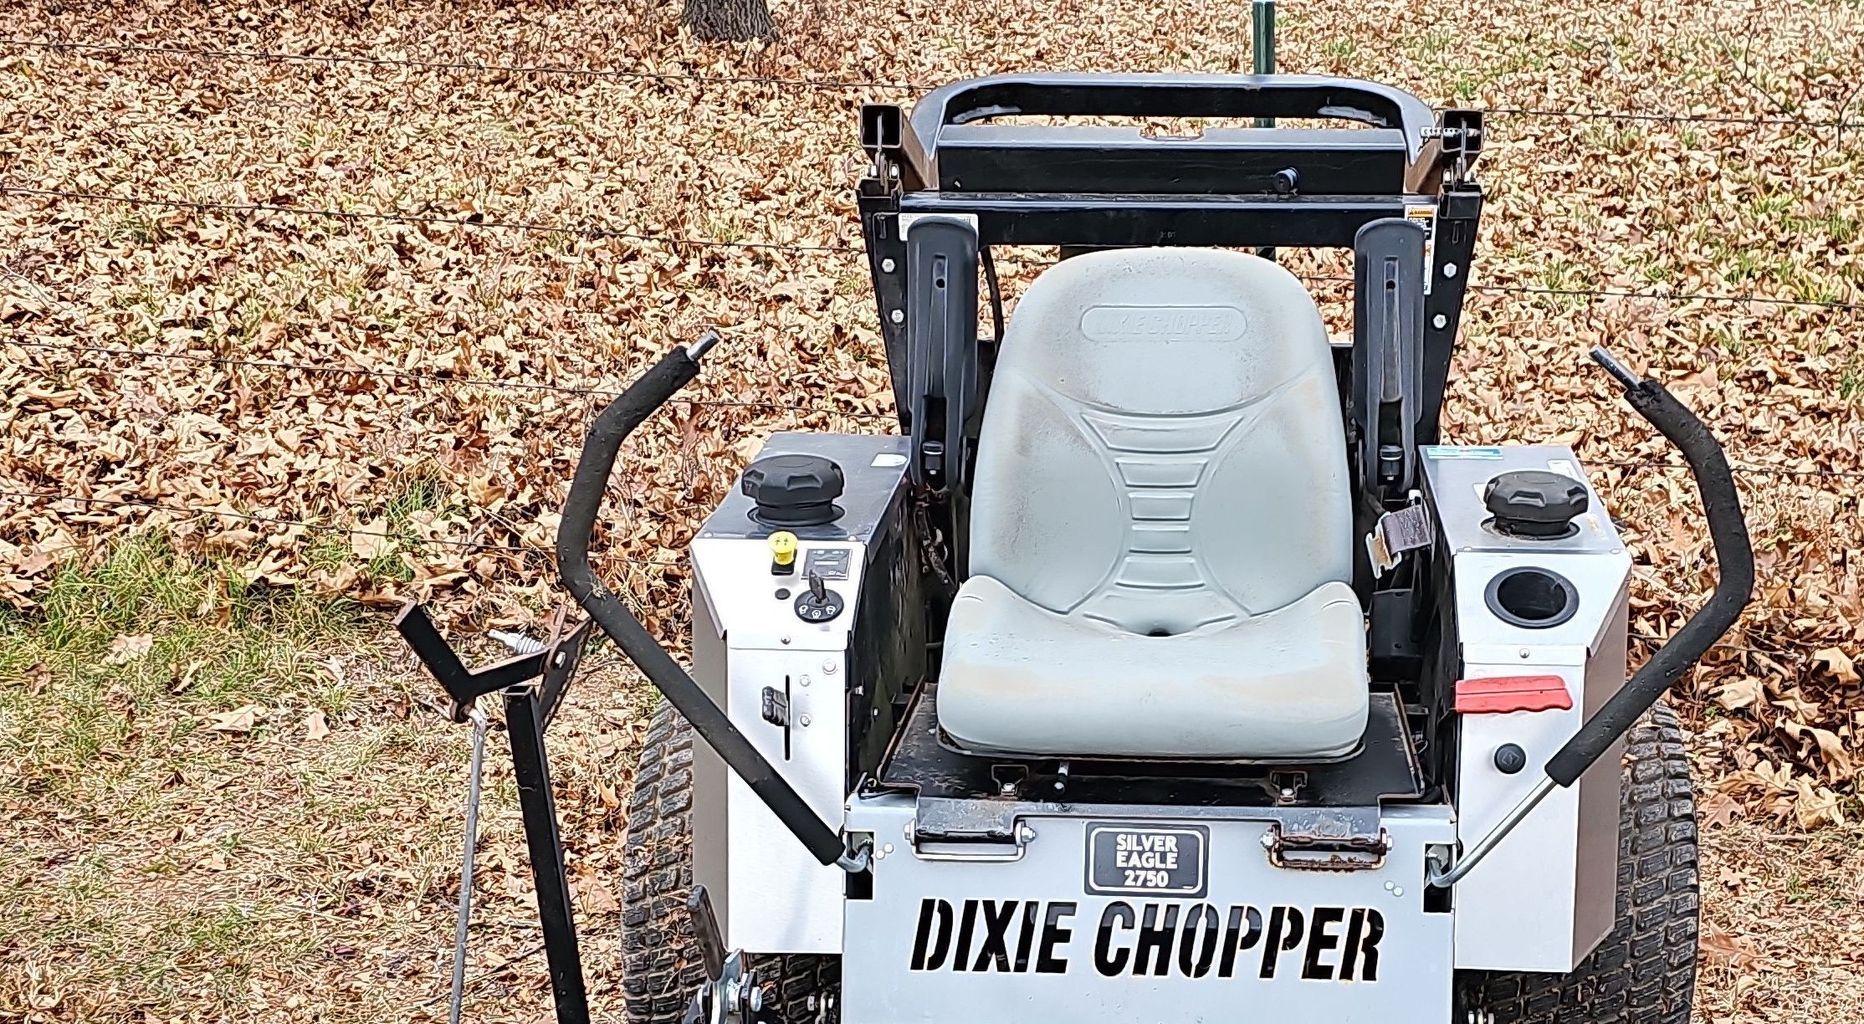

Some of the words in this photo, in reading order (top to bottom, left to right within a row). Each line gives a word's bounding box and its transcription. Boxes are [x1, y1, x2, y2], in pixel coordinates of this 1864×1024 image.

[1116, 834, 1178, 852] SILVER
[1116, 851, 1178, 869] EAGLE
[1124, 870, 1169, 887] 2750
[910, 898, 1078, 974] DIXIE
[1094, 901, 1385, 982] CHOPPER
